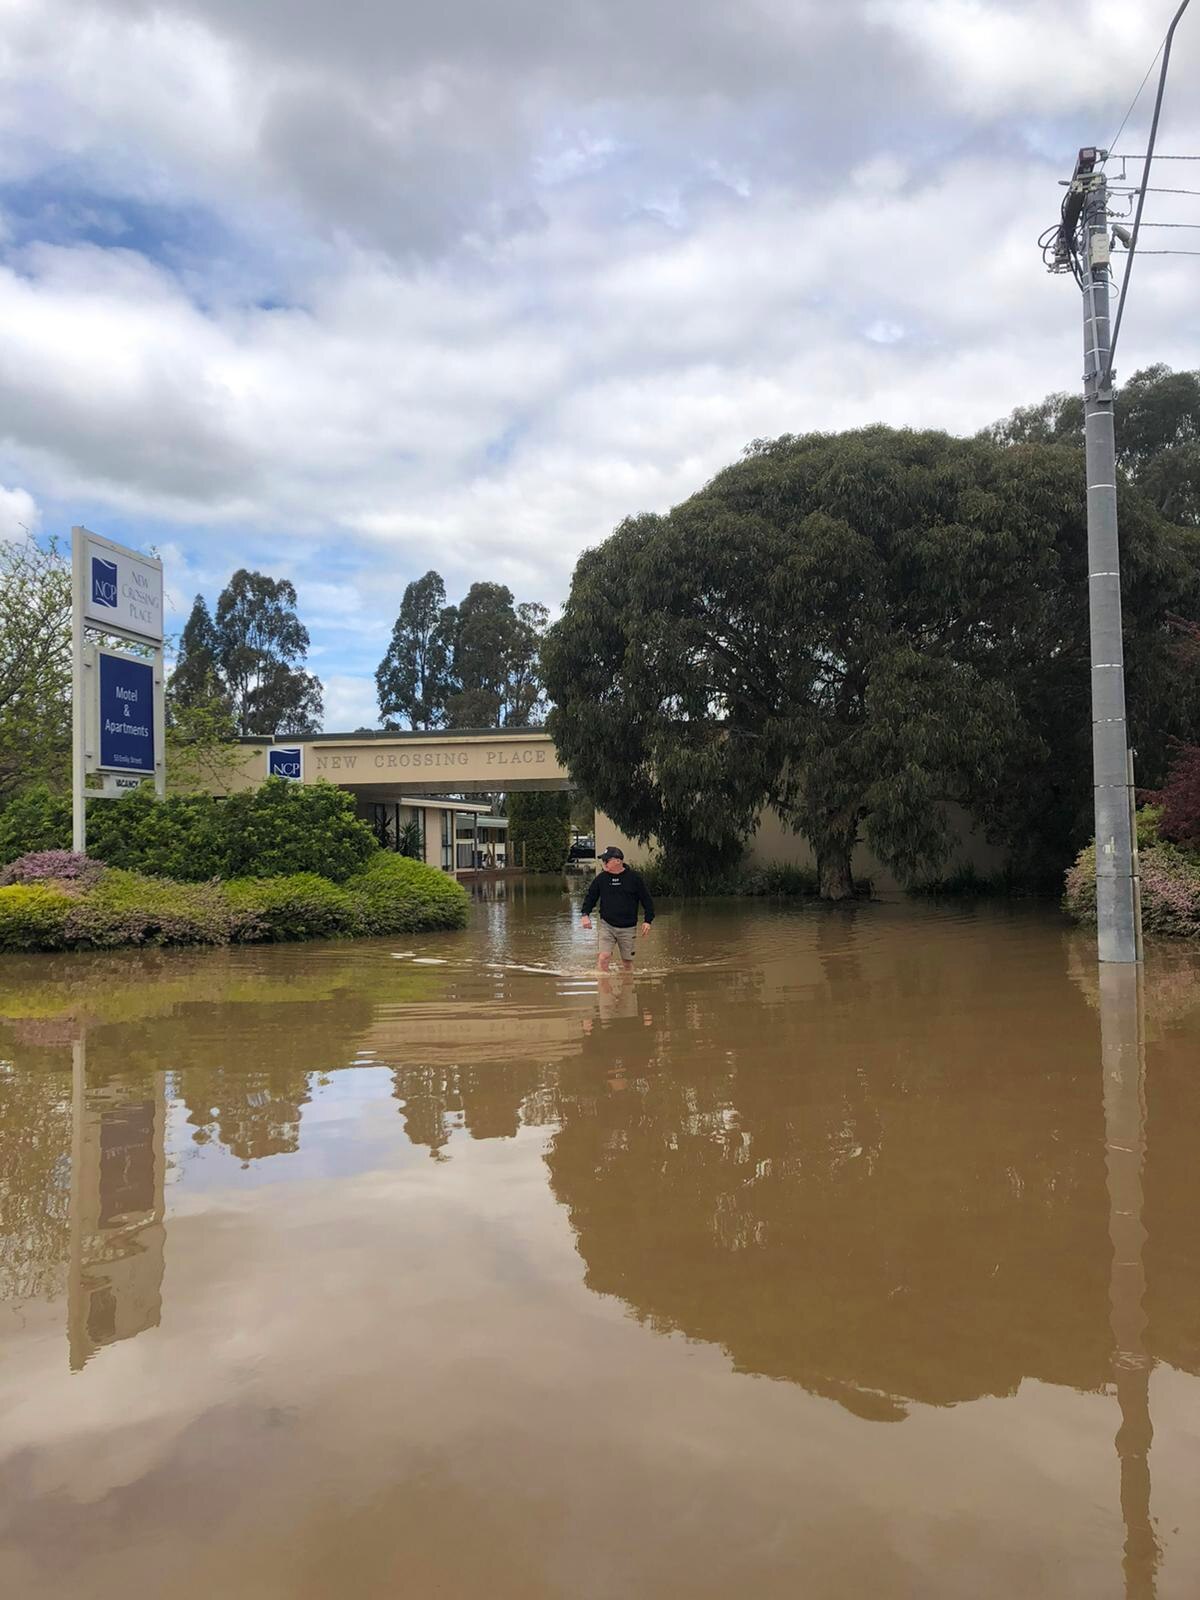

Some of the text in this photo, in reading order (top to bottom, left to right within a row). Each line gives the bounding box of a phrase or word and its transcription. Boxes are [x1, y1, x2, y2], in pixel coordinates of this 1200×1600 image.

[131, 571, 150, 589] NEW
[95, 579, 117, 601] NCP
[122, 584, 159, 609] CROSSING
[130, 602, 153, 624] PLACE
[115, 686, 138, 702] Motel
[123, 704, 130, 717] &
[105, 719, 149, 737] Apartments
[273, 762, 300, 775] NCP
[317, 750, 546, 769] NEW CROSSING PLACE
[115, 779, 138, 788] VACANCY
